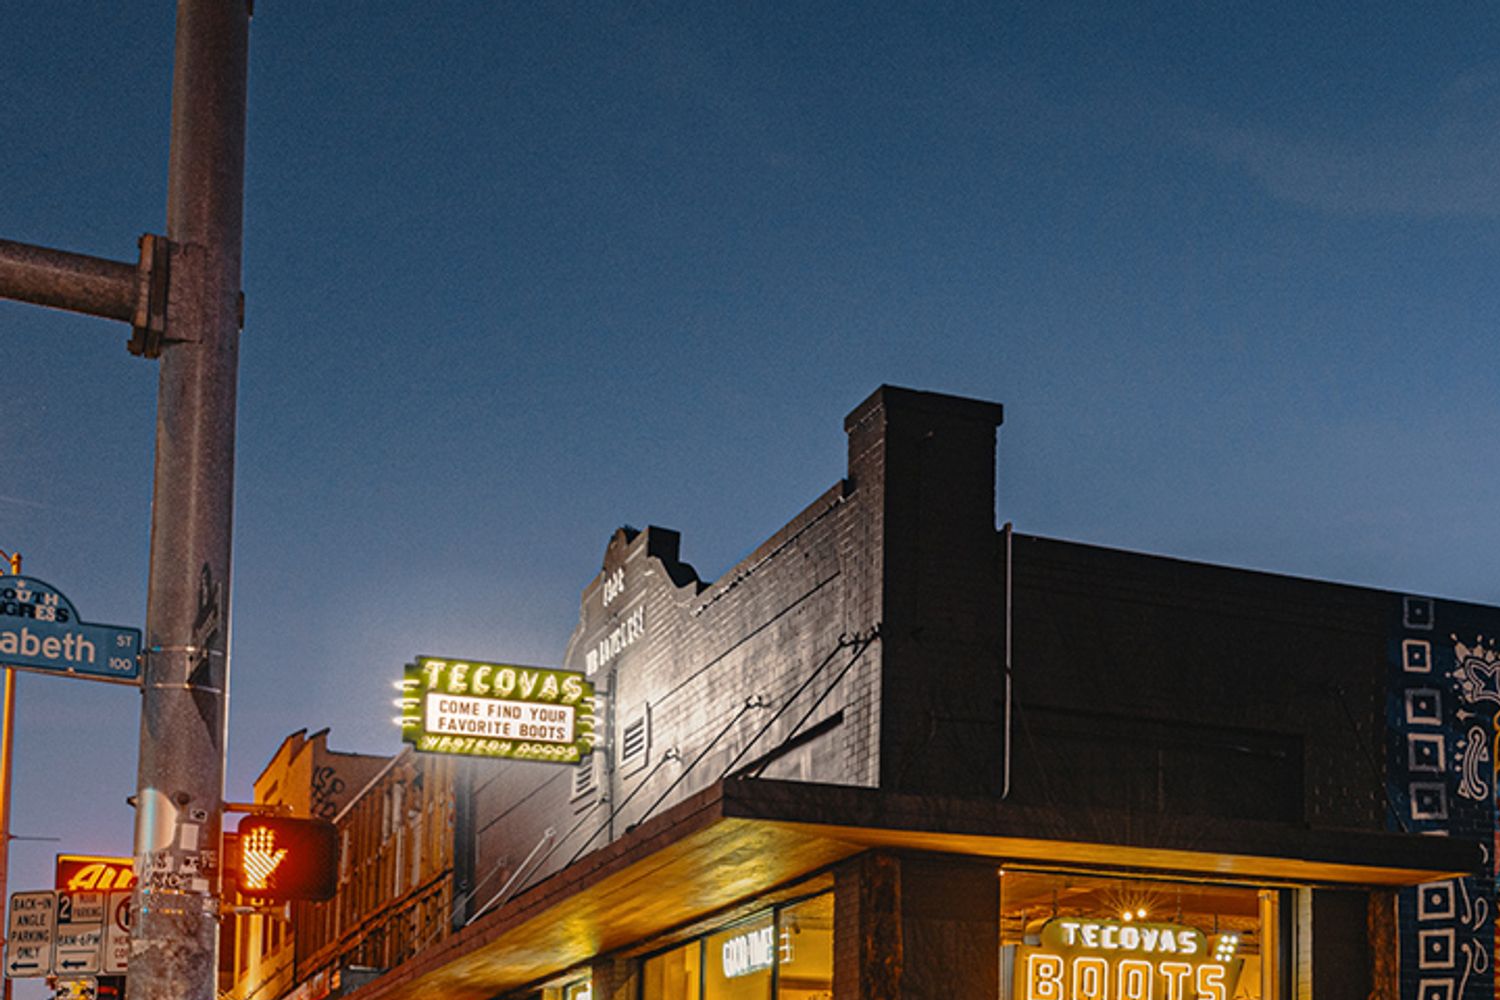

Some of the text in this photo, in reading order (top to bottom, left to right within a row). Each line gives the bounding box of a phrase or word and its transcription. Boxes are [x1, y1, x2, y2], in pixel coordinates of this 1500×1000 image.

[0, 588, 58, 606] OUTH
[0, 602, 69, 623] GRESS
[116, 635, 132, 647] ST
[109, 657, 132, 670] 100
[422, 661, 583, 704] TECOVAS
[439, 700, 567, 723] COME FIND YOUR
[438, 717, 566, 740] FAVORITE BOOTS
[68, 864, 138, 891] All
[13, 898, 52, 911] BACK-IN
[60, 895, 71, 918] 2
[17, 913, 46, 926] ANGLE
[11, 929, 49, 942] PARKING
[1061, 923, 1198, 953] TECOVAS
[17, 947, 40, 959] ONLY
